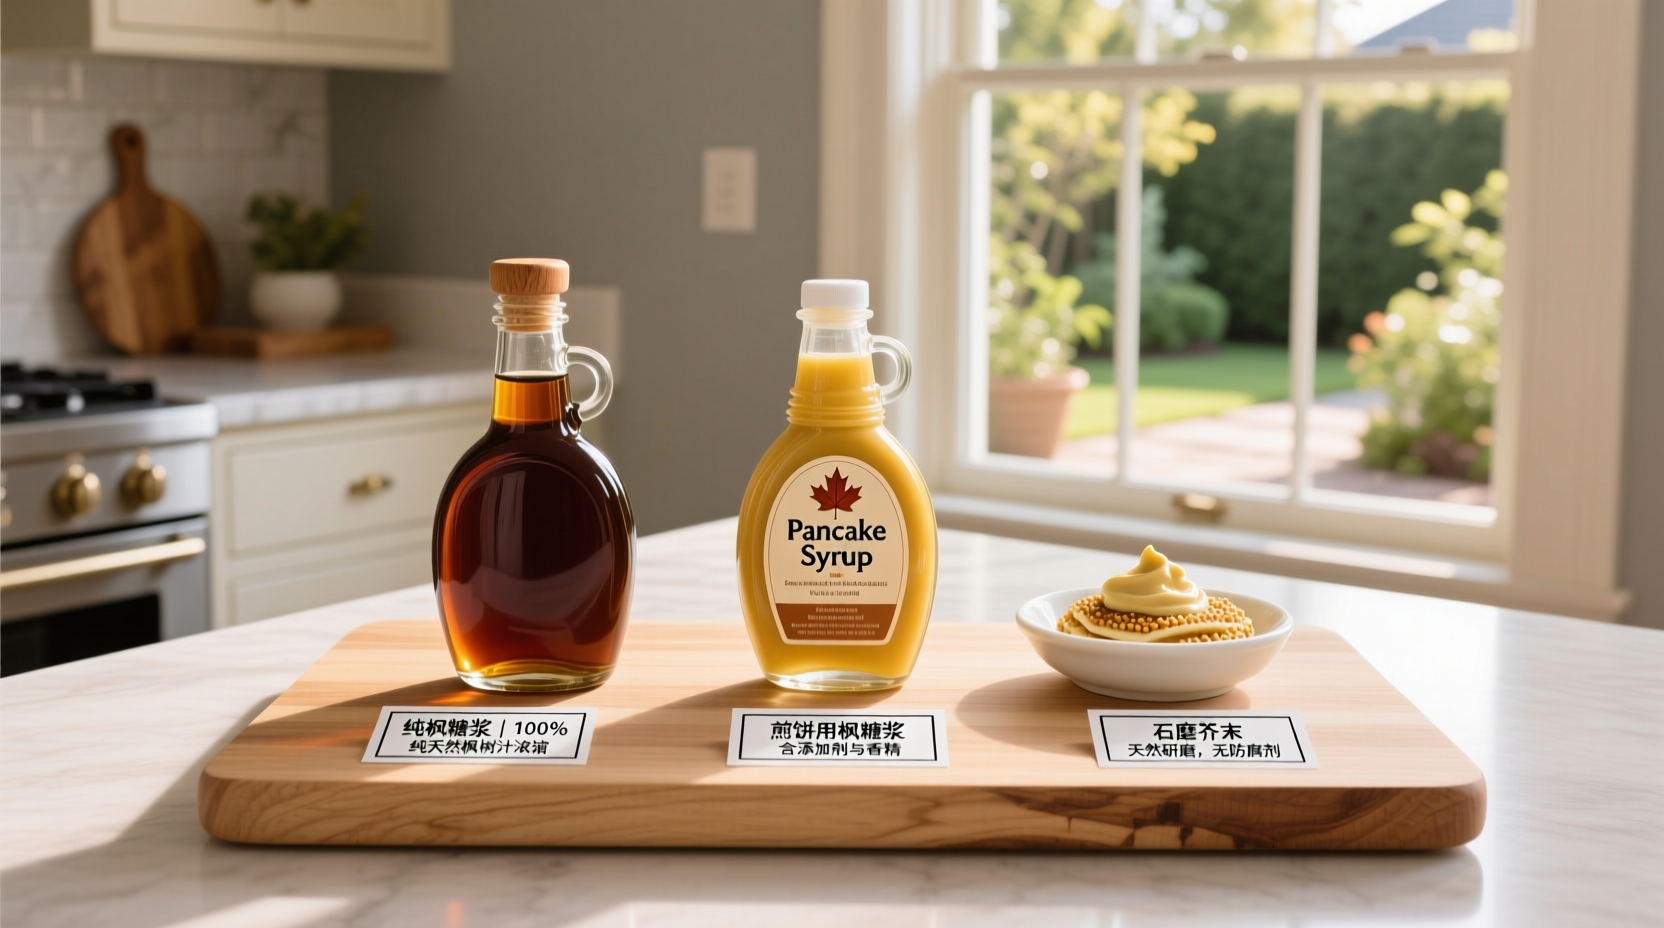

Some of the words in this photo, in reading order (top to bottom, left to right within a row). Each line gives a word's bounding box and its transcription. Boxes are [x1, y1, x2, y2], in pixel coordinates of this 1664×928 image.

[787, 518, 887, 541] Pancake
[800, 544, 873, 573] Syrup
[401, 718, 493, 738] 纯枫糖浆
[514, 721, 568, 736] 100%
[770, 720, 905, 740] 煎饼用枫糖浆
